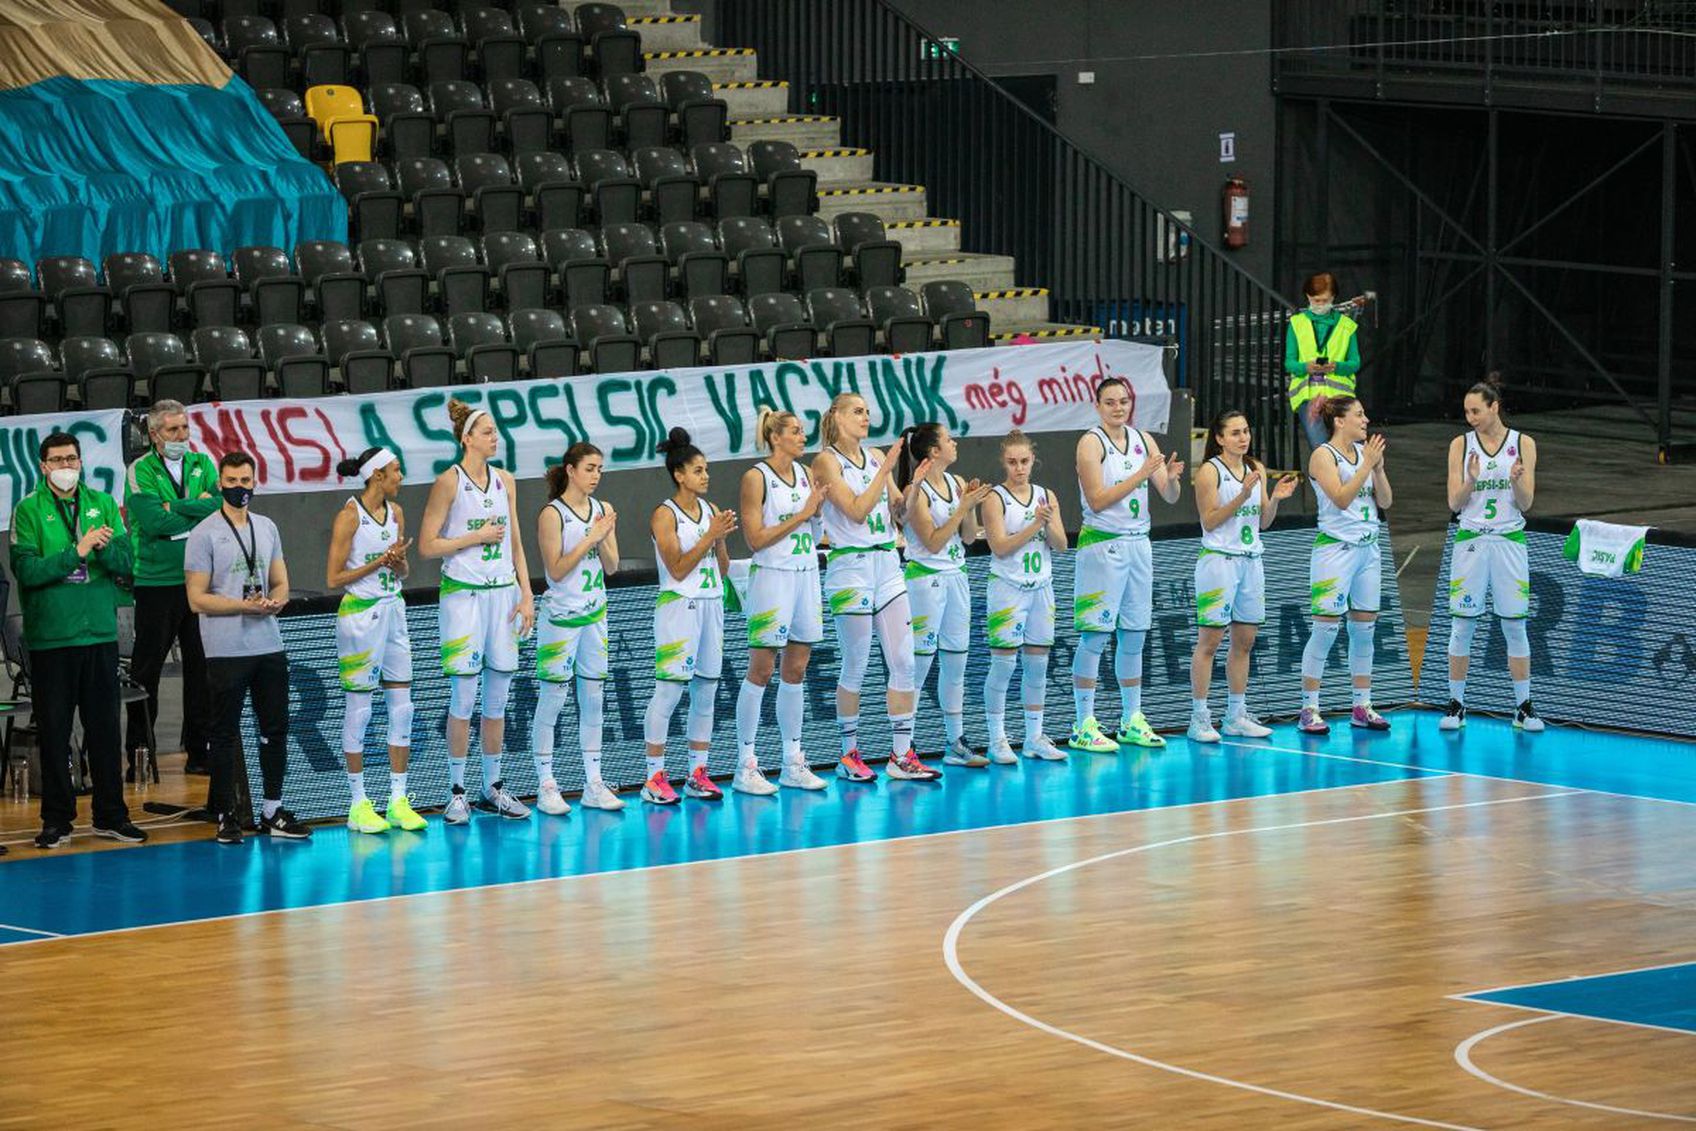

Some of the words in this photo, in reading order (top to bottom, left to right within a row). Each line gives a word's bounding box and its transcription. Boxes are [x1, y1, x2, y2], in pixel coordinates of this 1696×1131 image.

[360, 402, 406, 477] A
[597, 375, 677, 462] SIC
[965, 366, 1028, 426] még
[1037, 353, 1137, 426] mindg
[1129, 498, 1140, 519] 9
[1485, 498, 1497, 520] 5
[790, 533, 812, 555] 20
[1241, 525, 1254, 545] 8
[482, 543, 502, 561] 32
[1023, 551, 1041, 573] 10
[582, 569, 604, 592] 24
[699, 567, 717, 589] 21
